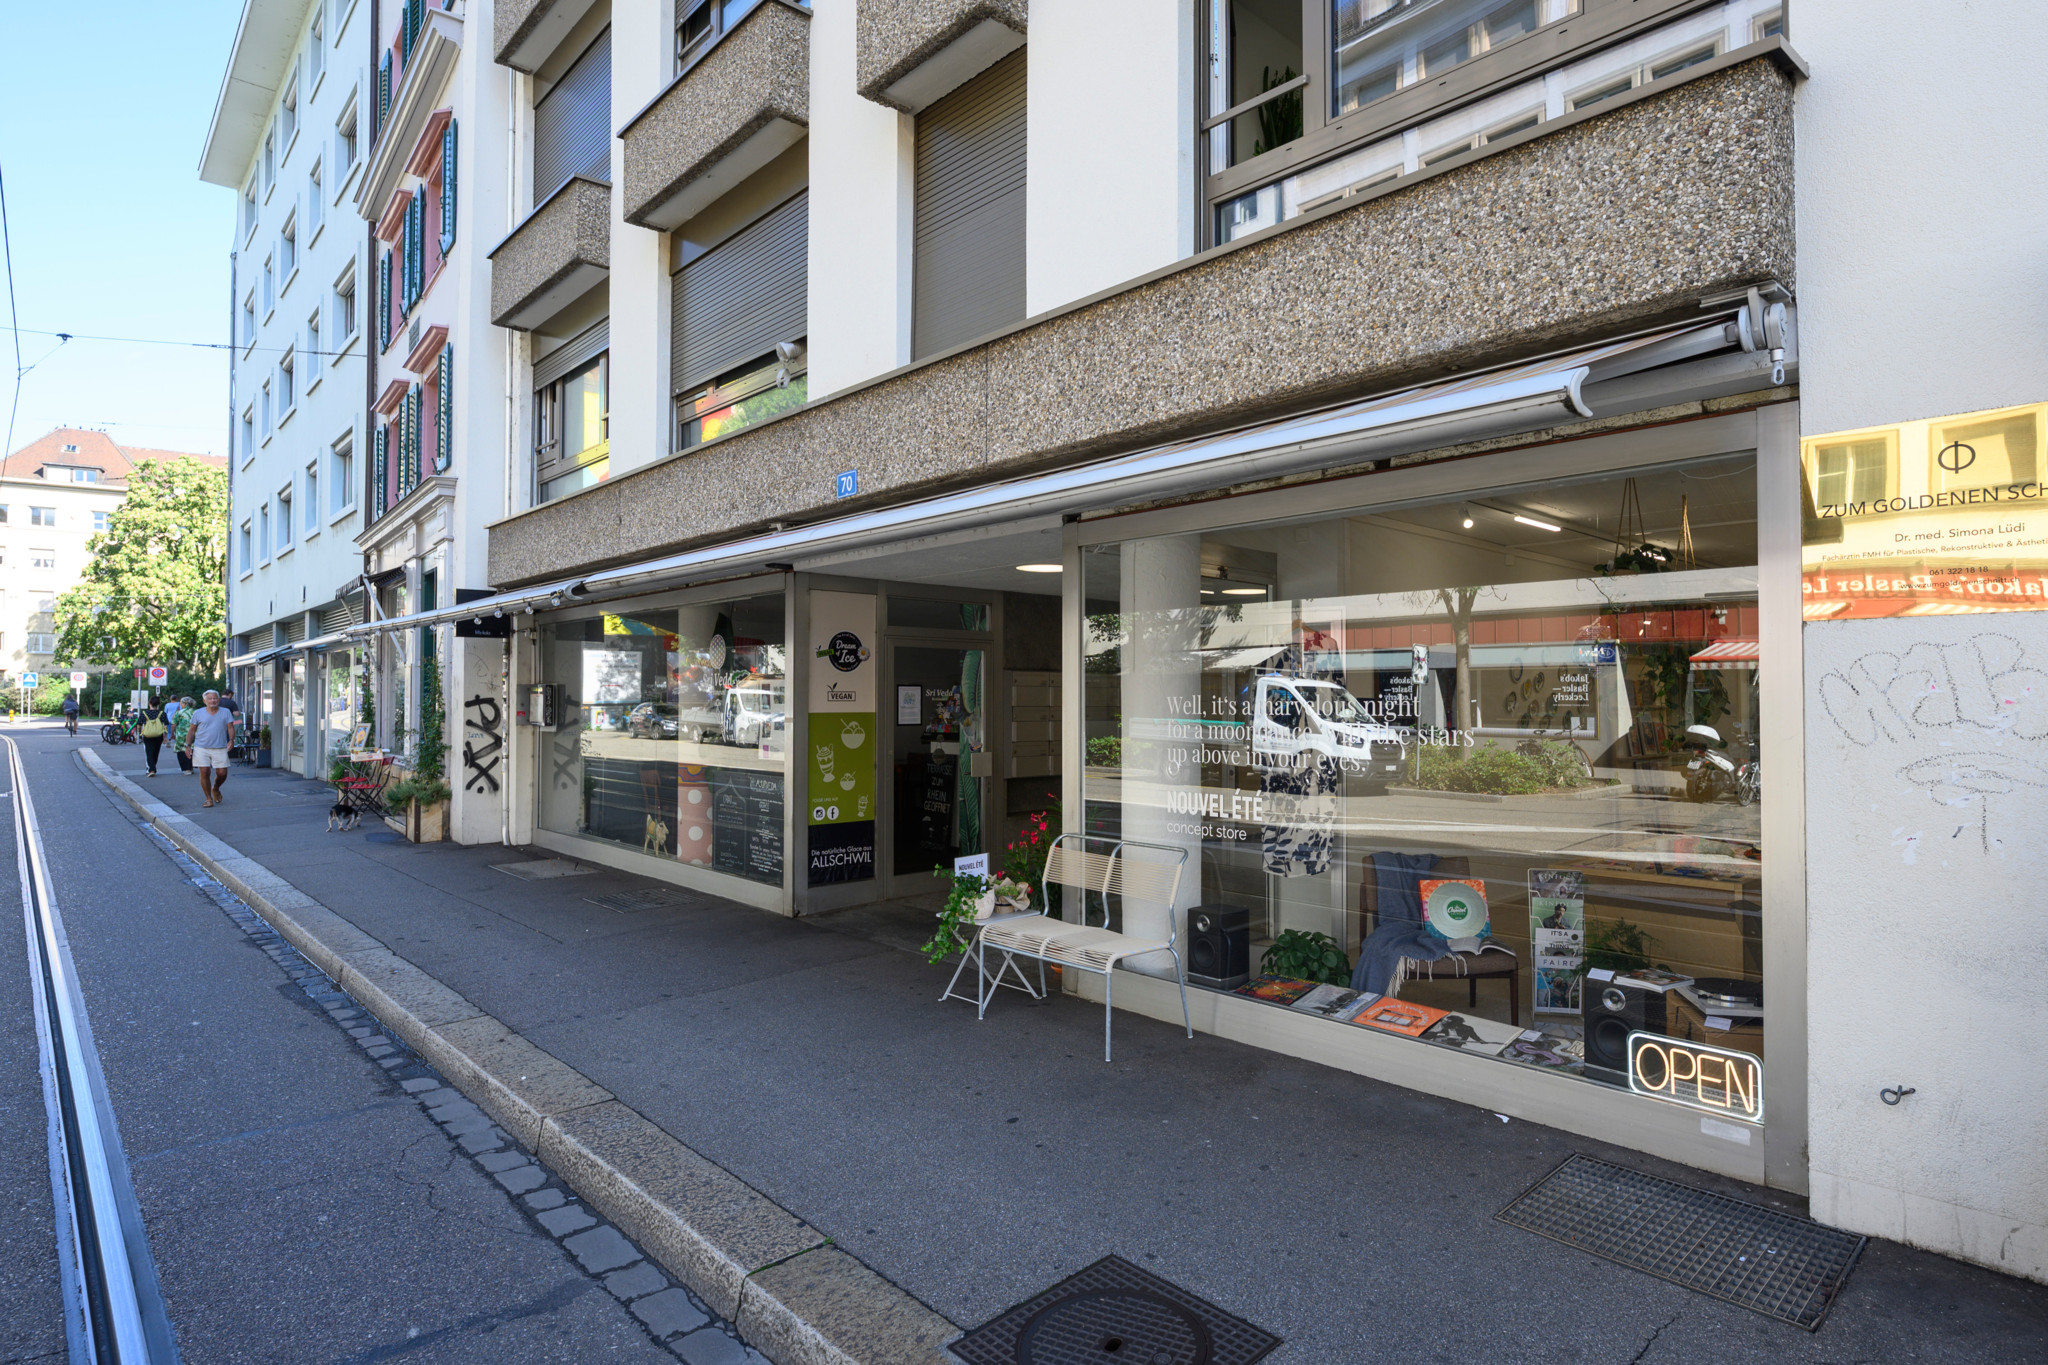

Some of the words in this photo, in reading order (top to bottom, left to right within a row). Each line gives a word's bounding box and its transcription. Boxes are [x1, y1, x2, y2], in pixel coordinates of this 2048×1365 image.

[840, 476, 852, 493] 70
[1822, 501, 1866, 519] ZUM
[1874, 487, 1999, 513] GOLDENEN
[1894, 533, 1911, 543] Dr.
[1914, 530, 1944, 542] med.
[1948, 527, 1994, 538] Simona
[1998, 522, 2026, 534] Lüdi
[1822, 552, 1860, 562] Fachärztin
[1883, 549, 1894, 557] für
[1896, 546, 1938, 556] Plastische,
[1940, 541, 2004, 552] Rekonstruktive
[2006, 540, 2014, 548] &
[1929, 568, 1944, 576] 061
[1947, 567, 1963, 576] 322
[1966, 566, 1976, 574] 18
[1978, 566, 1989, 574] 18
[836, 640, 857, 650] Dream
[839, 650, 856, 663] Ice
[926, 688, 936, 697] Sri
[1168, 695, 1207, 718] Well,
[1242, 701, 1251, 716] a
[1364, 694, 1421, 722] night
[1168, 721, 1190, 739] for
[1194, 726, 1202, 740] a
[1376, 722, 1410, 746] the
[1418, 725, 1476, 748] stars
[1168, 748, 1188, 768] up
[1192, 744, 1240, 765] above
[1246, 745, 1262, 766] in
[1268, 752, 1312, 772] your
[1316, 755, 1366, 774] eyes.
[927, 788, 947, 802] RHEIN
[1167, 790, 1229, 818] NOUVEL
[1232, 788, 1263, 822] ÉTÉ
[1166, 822, 1213, 839] concept
[1216, 825, 1247, 841] store
[821, 846, 846, 855] natürliche
[811, 852, 872, 868] ALLSCHWIL
[958, 862, 976, 871] NOUVEL
[976, 860, 984, 868] ÉTÉ
[1636, 1043, 1755, 1114] OPEN
